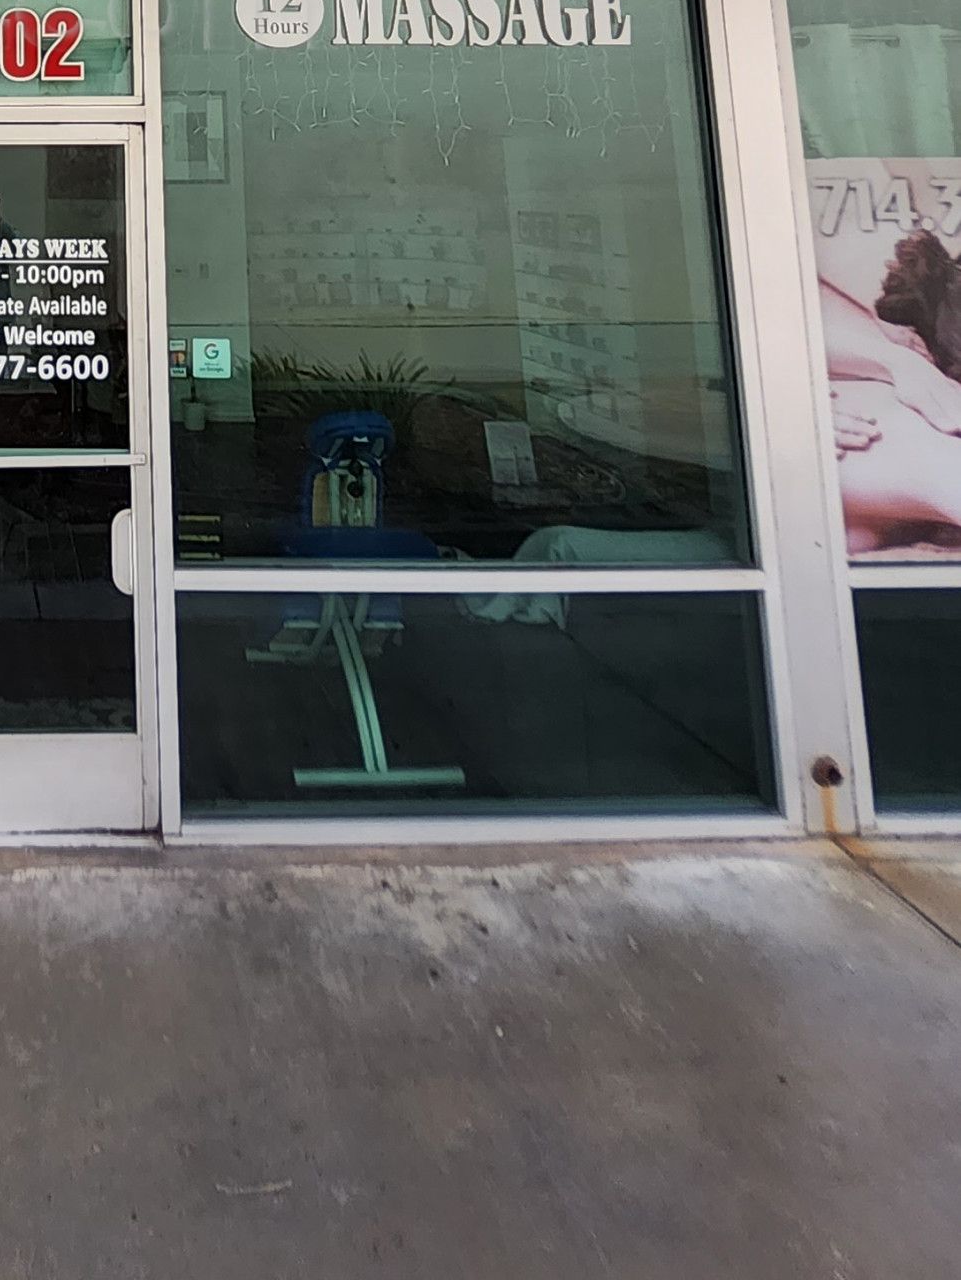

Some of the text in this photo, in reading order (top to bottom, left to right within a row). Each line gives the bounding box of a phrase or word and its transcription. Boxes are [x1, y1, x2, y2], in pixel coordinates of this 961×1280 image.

[253, 17, 310, 36] Hours
[44, 238, 108, 259] WEEK
[16, 265, 105, 288] 10:00pm
[29, 295, 107, 315] Available
[3, 324, 96, 345] Welcome
